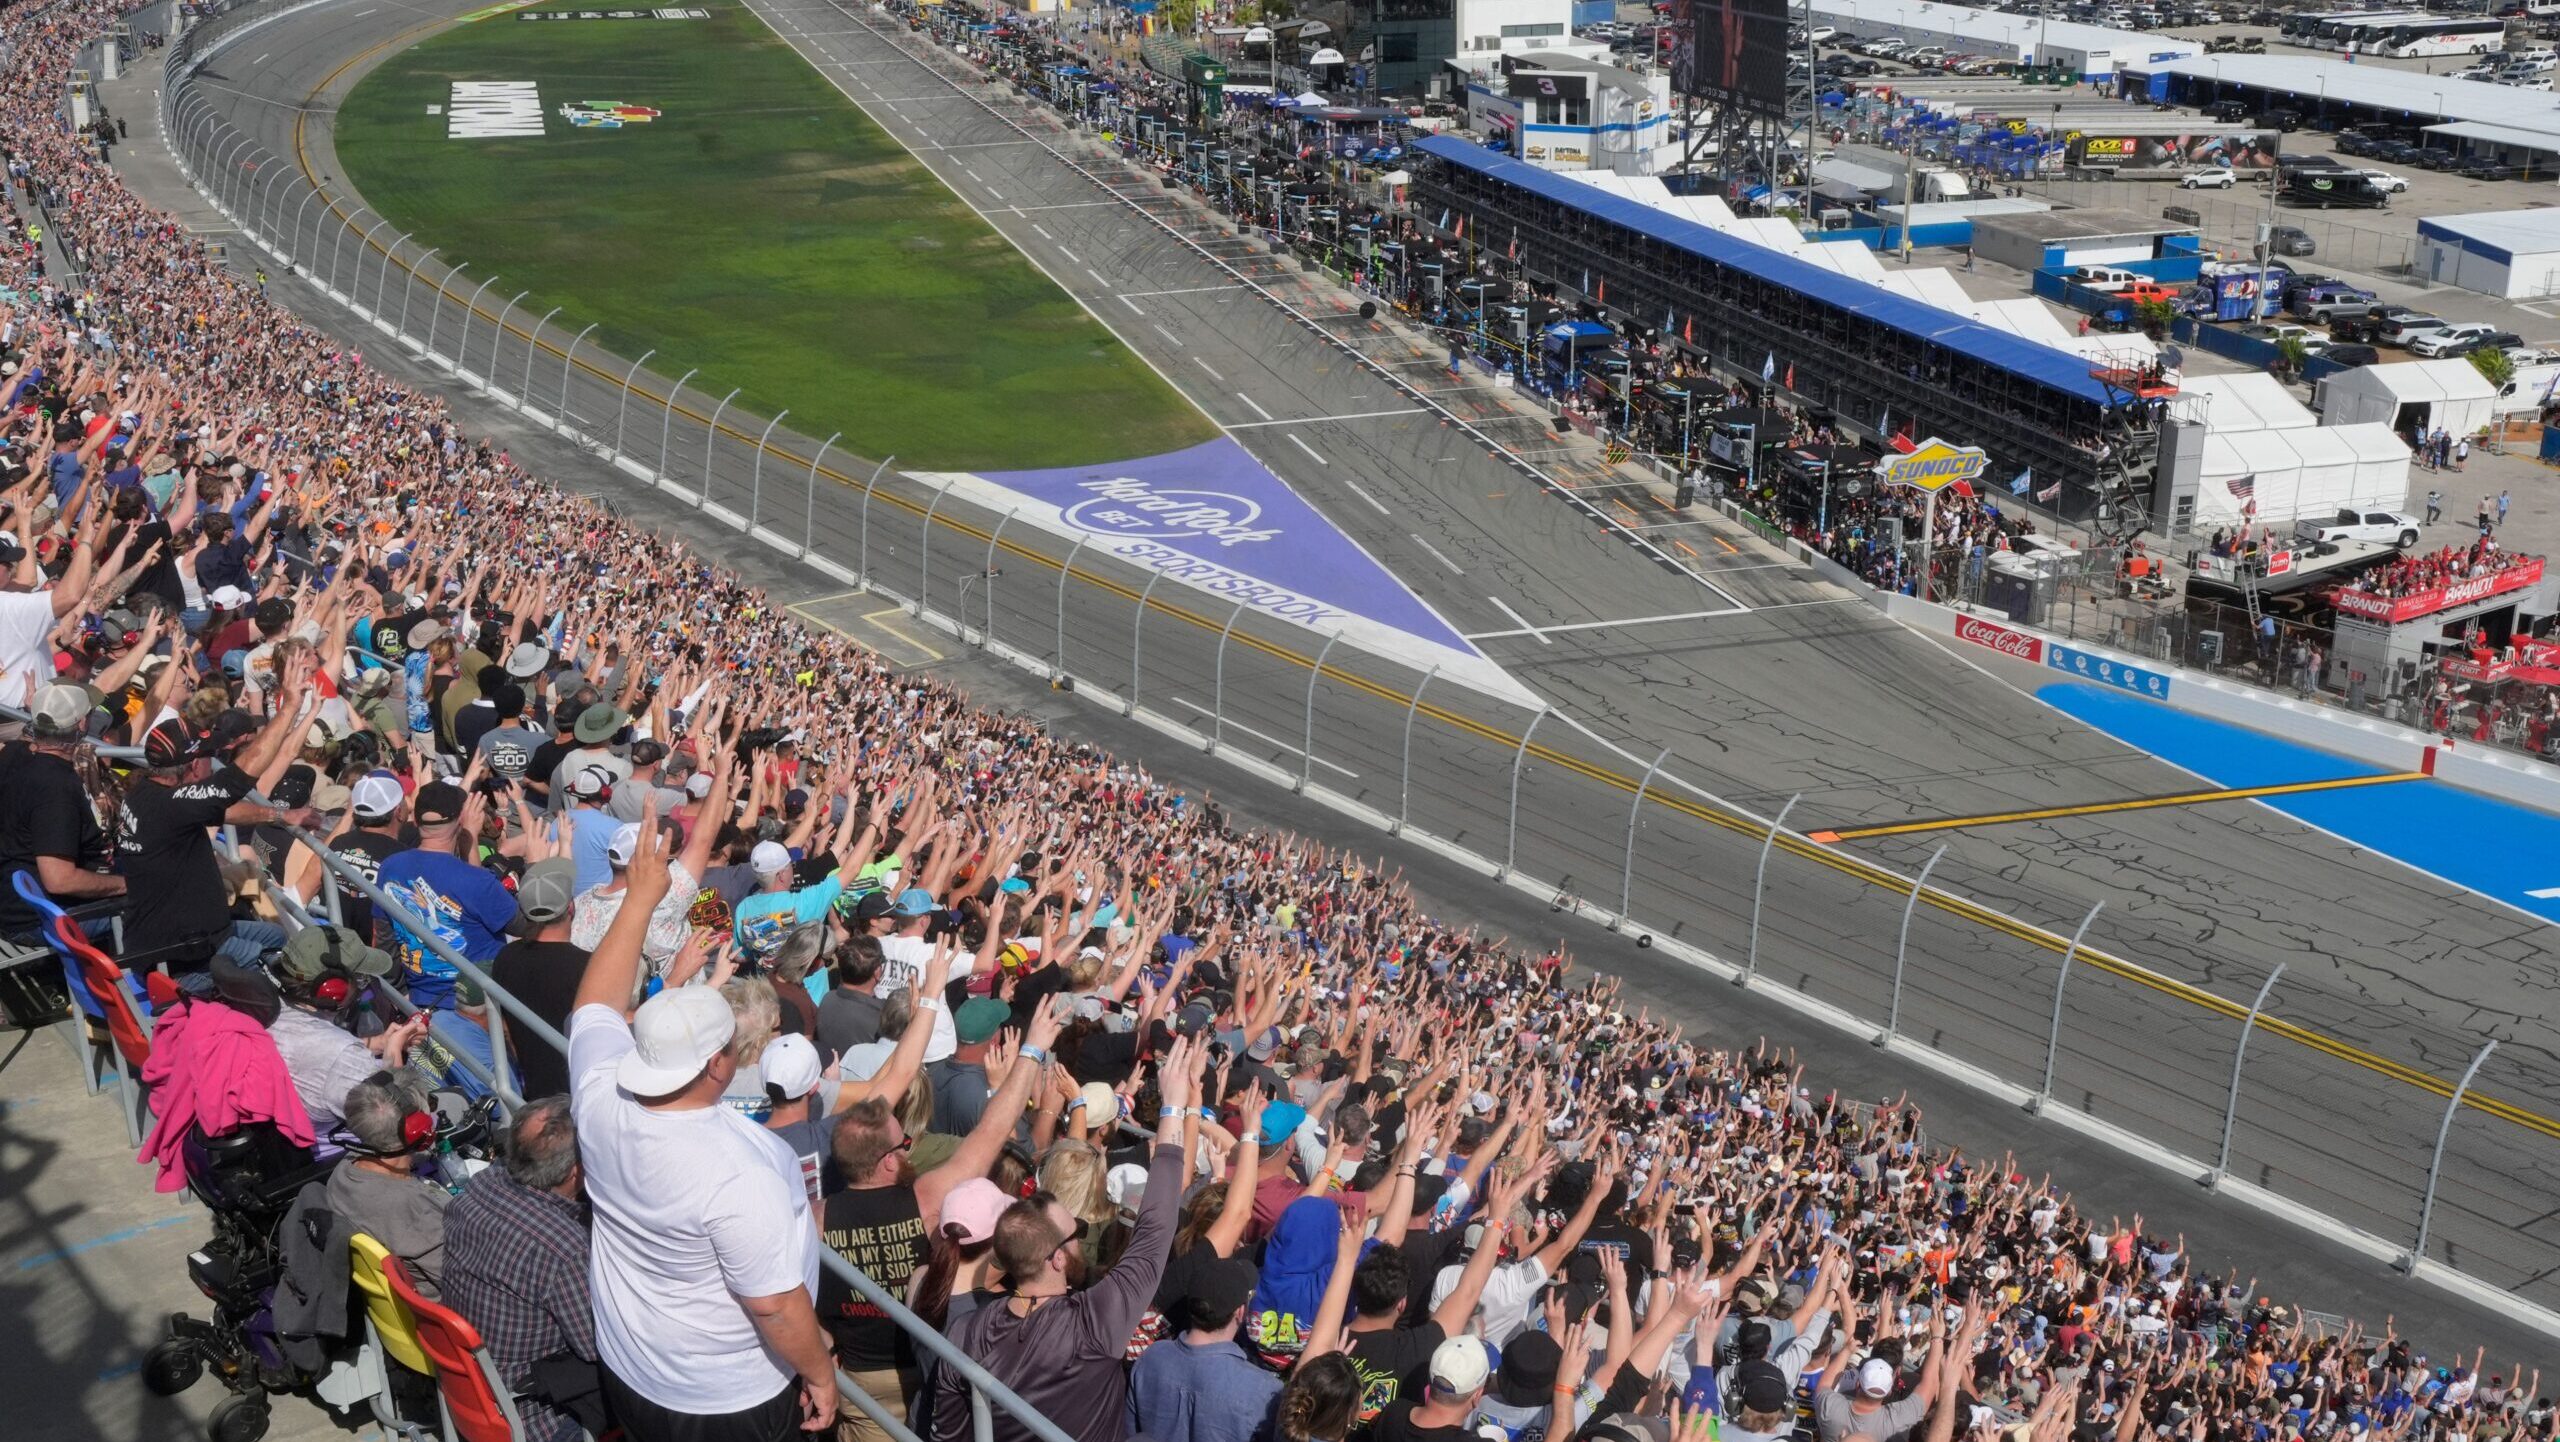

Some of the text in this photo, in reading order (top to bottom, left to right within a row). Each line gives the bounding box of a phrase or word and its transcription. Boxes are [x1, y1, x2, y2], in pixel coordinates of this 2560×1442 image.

[1537, 78, 1558, 95] 3
[1892, 456, 1980, 480] SUNOCO
[1091, 510, 1155, 528] BET
[1114, 543, 1348, 625] SPORTSBOOK
[2442, 576, 2494, 604] BRANDT
[2339, 594, 2394, 616] BRANDT
[1962, 620, 2034, 657] Coca-Cola
[494, 754, 527, 766] 500
[340, 853, 371, 867] DAYTONA
[414, 876, 462, 921] PREECE
[824, 1218, 924, 1248] YOU ARE EITHER
[840, 1241, 919, 1265] ON MY SIDE.
[864, 1264, 882, 1281] MY
[1259, 1310, 1299, 1345] 24
